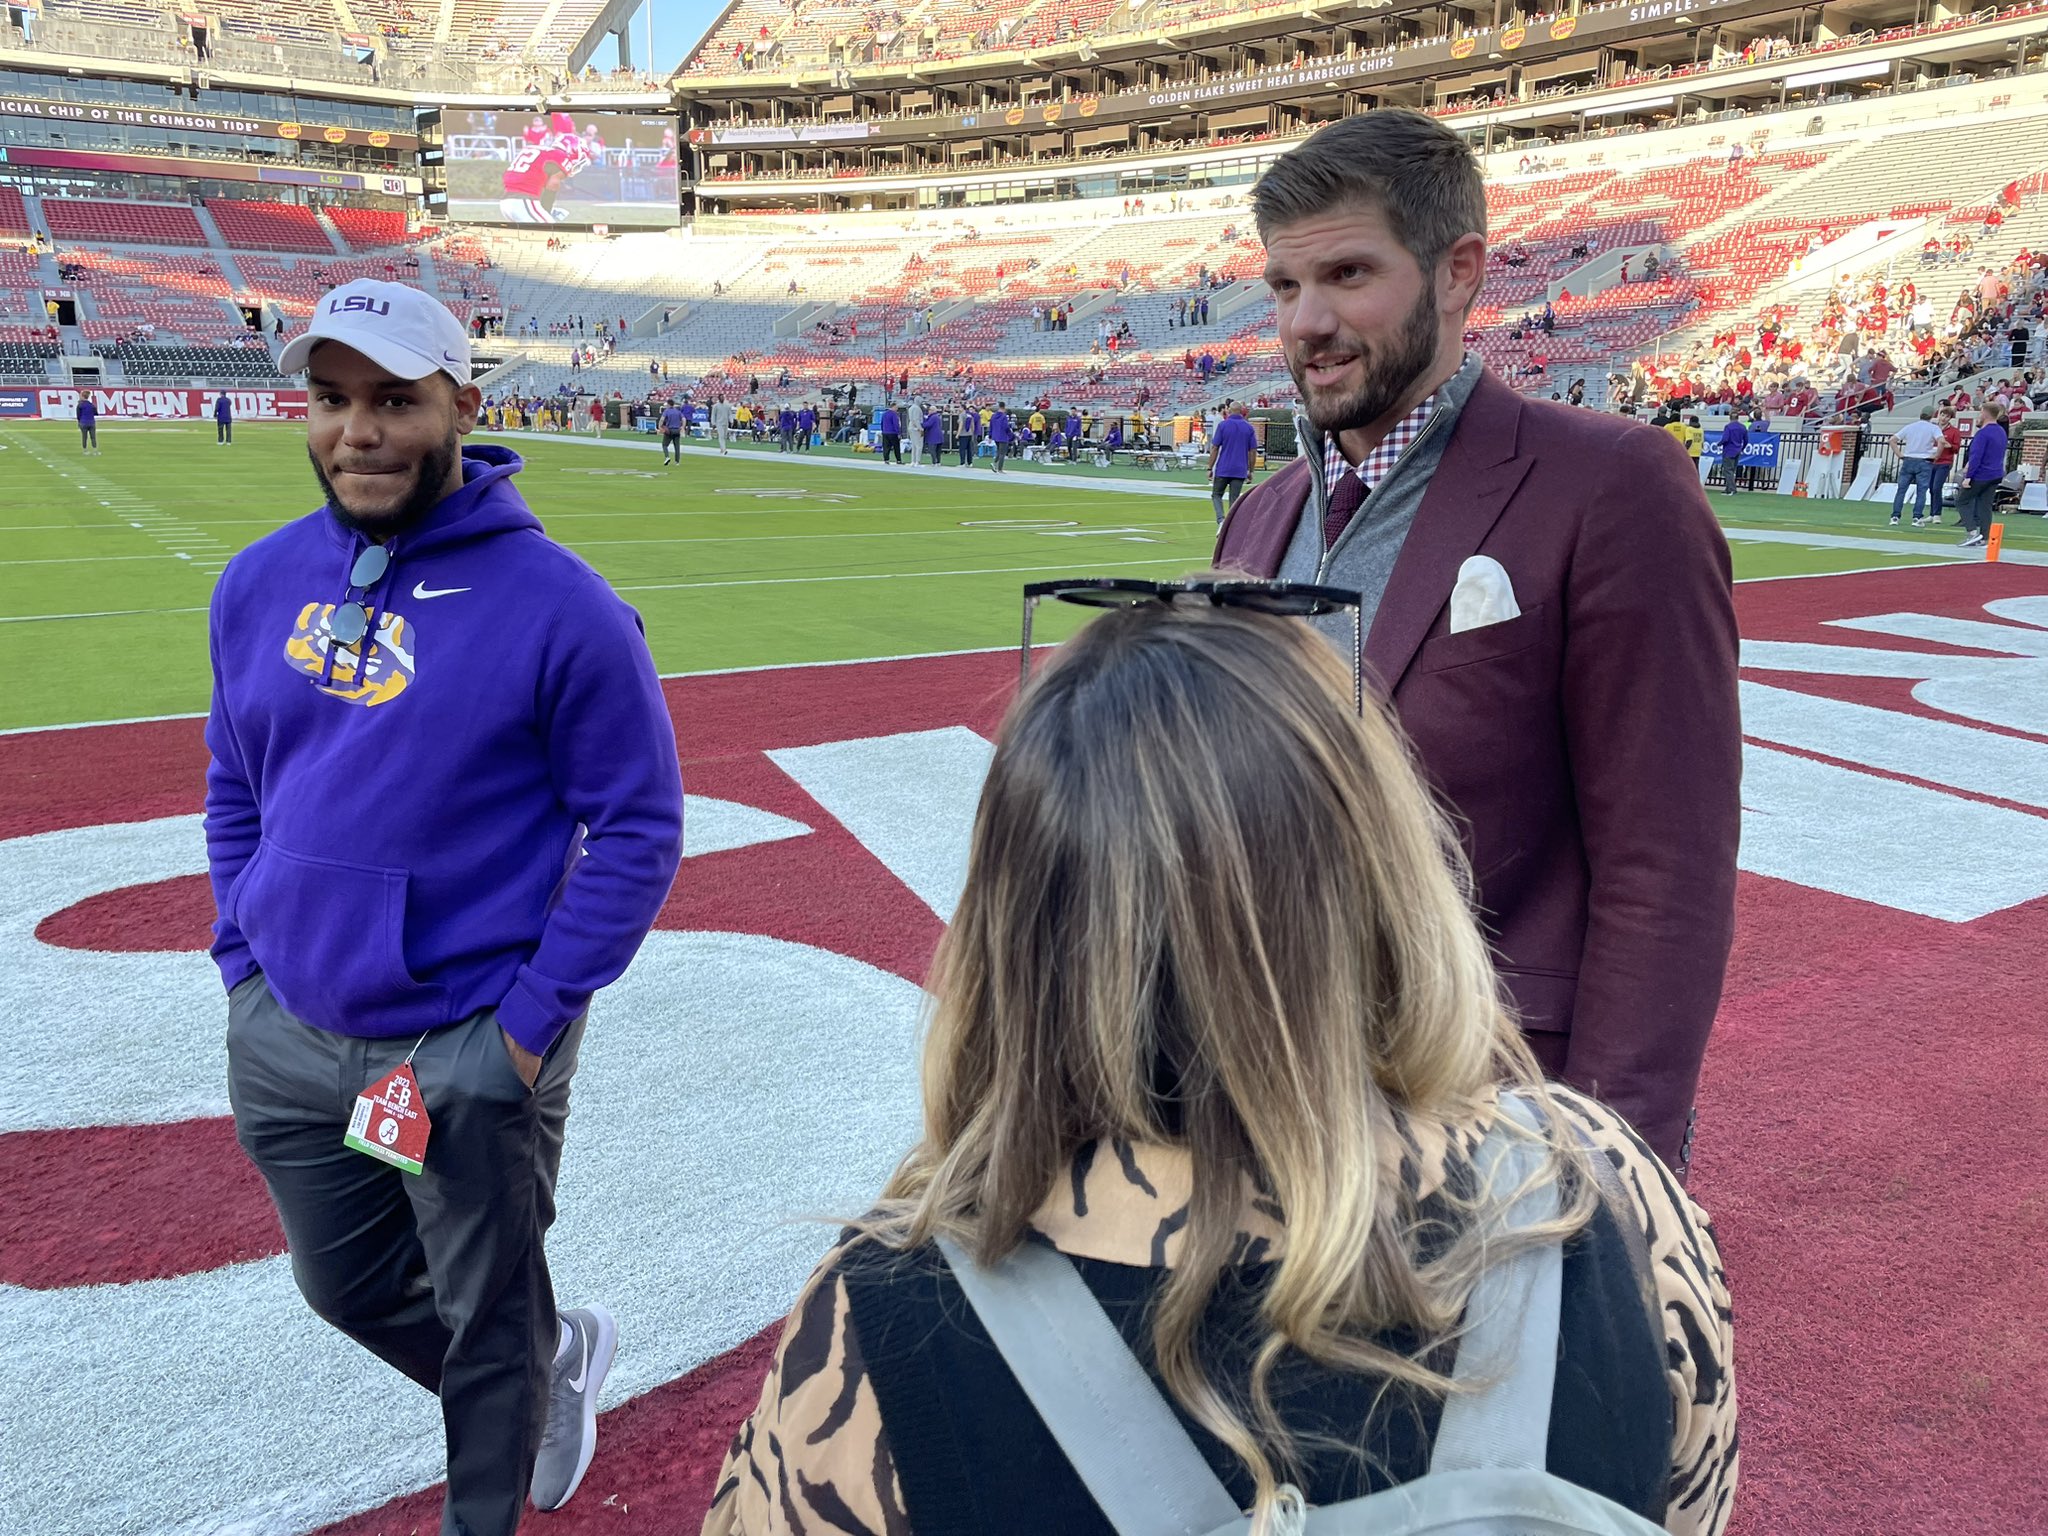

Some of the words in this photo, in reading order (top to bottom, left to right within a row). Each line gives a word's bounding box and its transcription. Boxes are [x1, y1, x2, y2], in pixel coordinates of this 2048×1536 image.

[1148, 89, 1190, 105] GOLDEN
[1194, 85, 1225, 99] FLAKE
[1229, 79, 1263, 93] SWEET
[1267, 73, 1294, 88] HEAT
[1299, 63, 1355, 82] BARBECUE
[1359, 56, 1394, 72] CHIPS
[48, 105, 84, 117] CHIP
[90, 109, 110, 119] OF
[116, 111, 143, 122] THE
[149, 114, 216, 129] CRIMSON
[320, 175, 342, 184] LSU
[383, 179, 401, 192] 40
[329, 296, 390, 316] LSU
[40, 390, 188, 418] CRMSON
[1790, 397, 1798, 407] 9
[1740, 442, 1774, 456] ORTS
[385, 1080, 412, 1108] F-B
[373, 1095, 388, 1107] TEAM
[387, 1101, 405, 1114] BENCH
[404, 1108, 418, 1120] EAST
